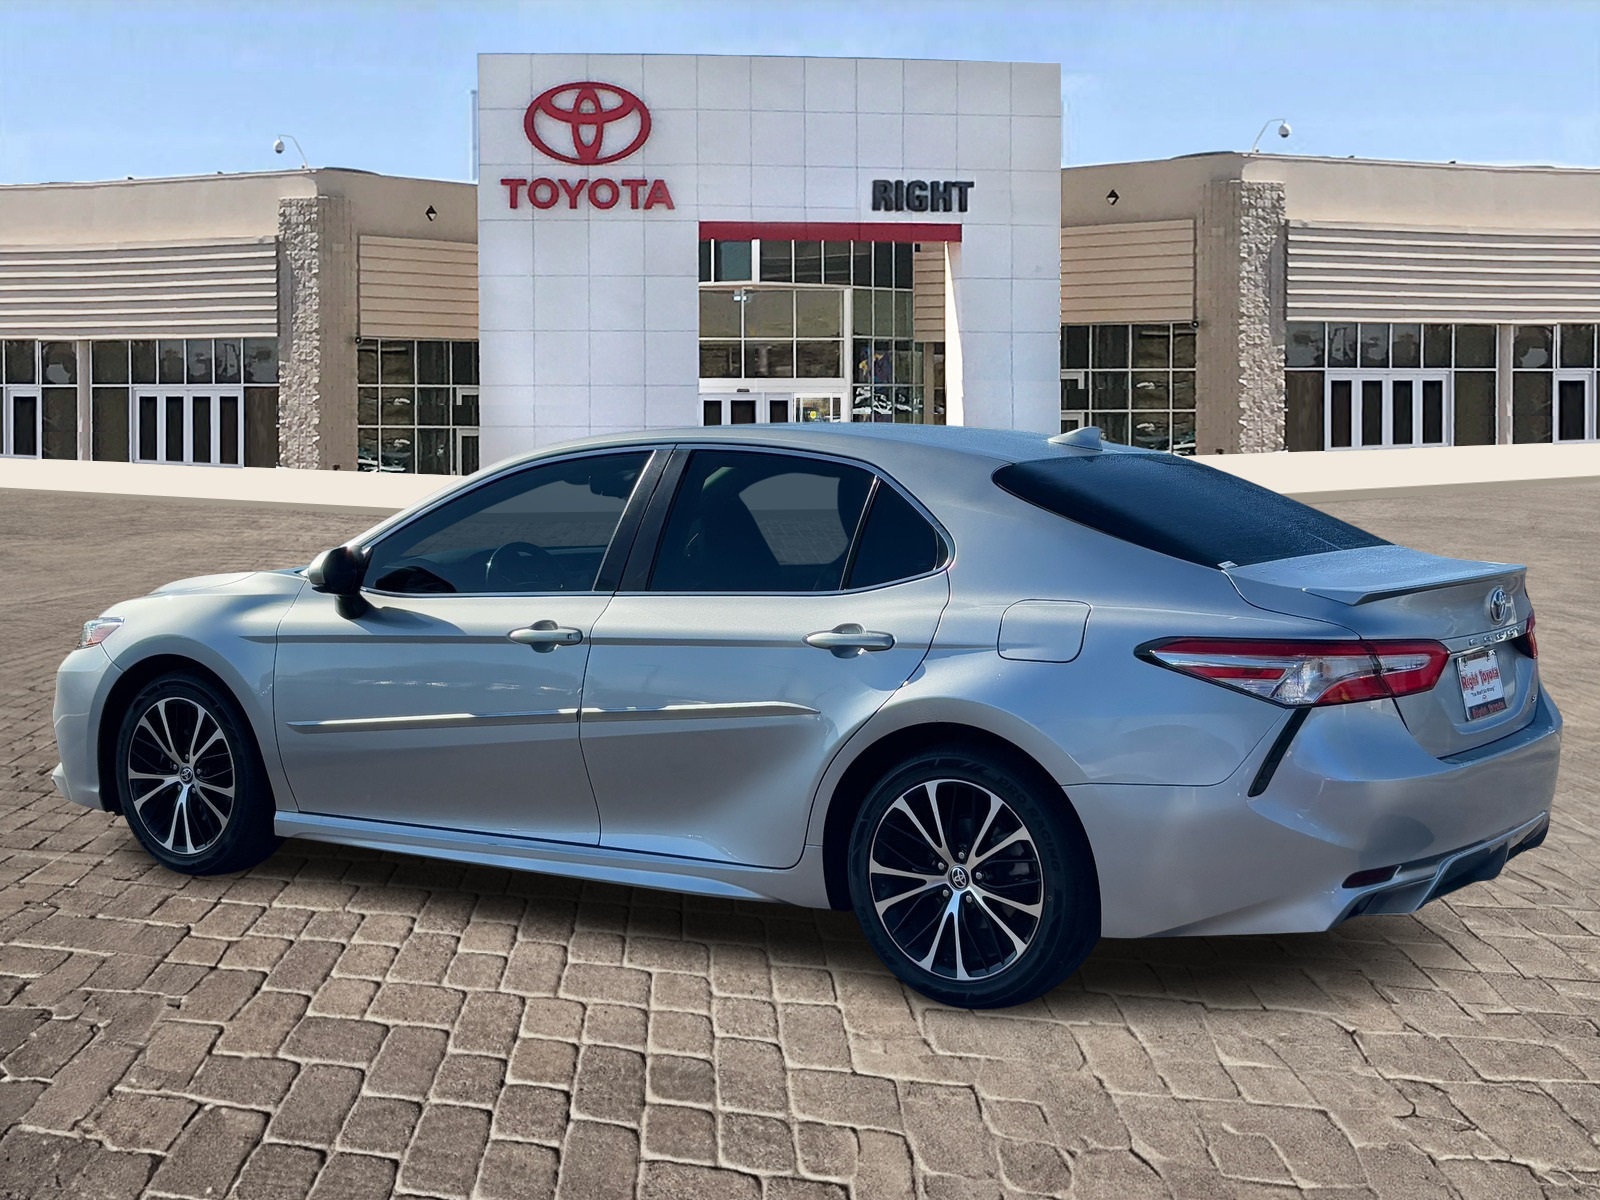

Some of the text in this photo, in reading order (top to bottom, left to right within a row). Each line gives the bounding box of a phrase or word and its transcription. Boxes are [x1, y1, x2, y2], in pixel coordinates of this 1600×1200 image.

[500, 177, 675, 210] TOYOTA
[872, 179, 975, 212] RIGHT
[1461, 672, 1479, 691] Right
[1479, 667, 1499, 686] Toyota
